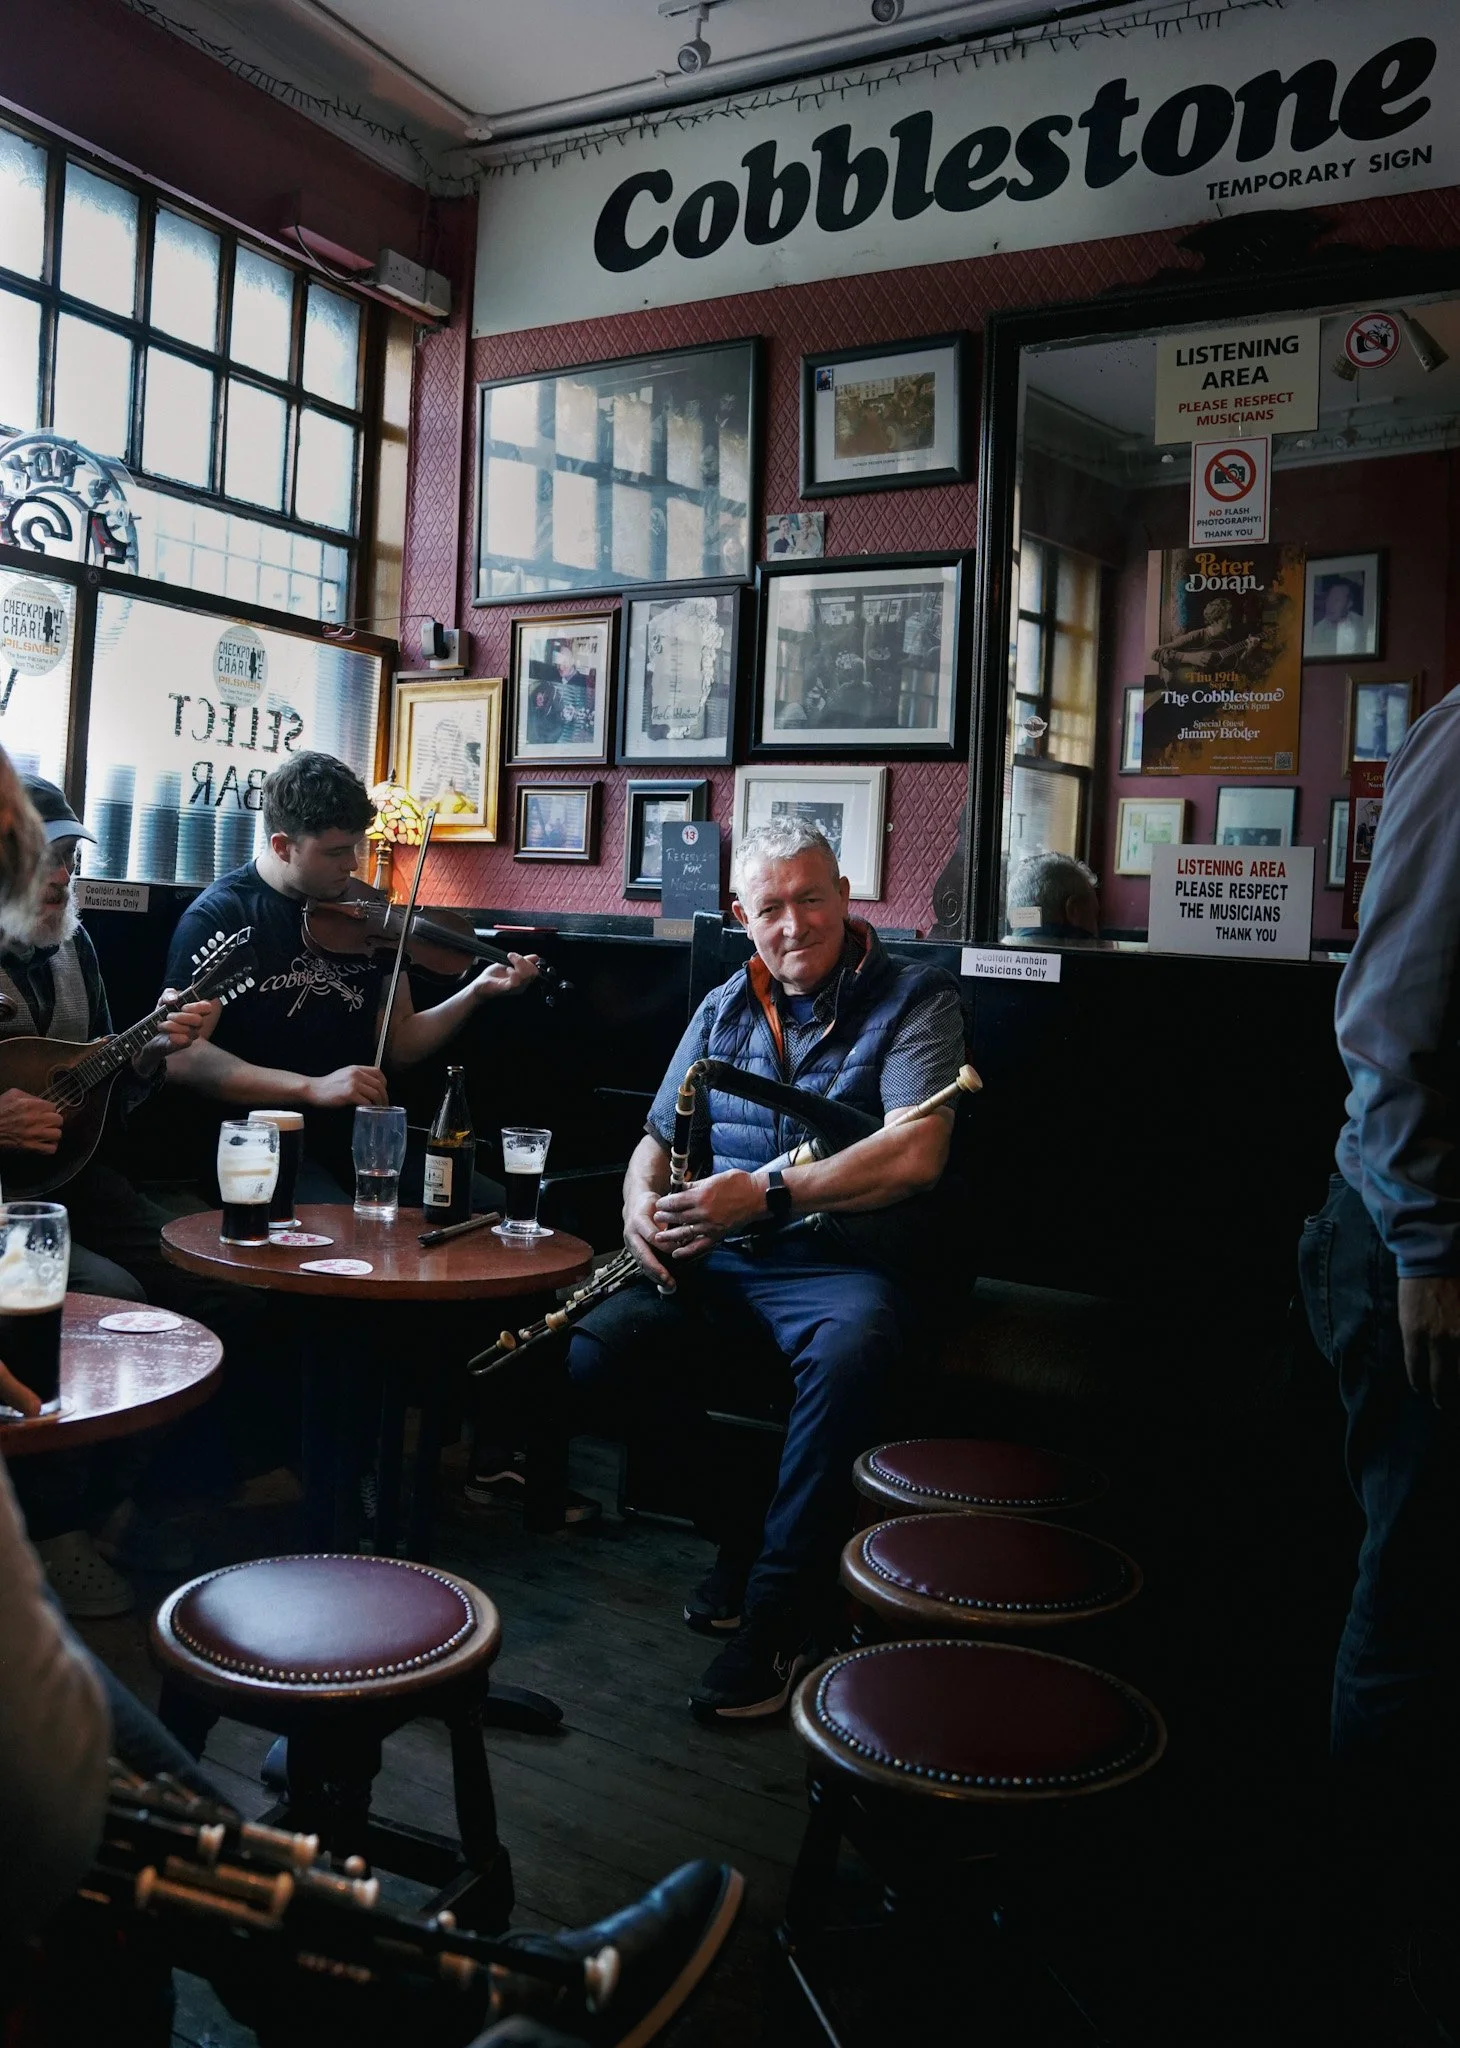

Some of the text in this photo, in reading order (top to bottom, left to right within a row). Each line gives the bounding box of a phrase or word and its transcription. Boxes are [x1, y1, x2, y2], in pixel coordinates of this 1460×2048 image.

[594, 37, 1438, 272] Cobblestone
[1207, 145, 1433, 200] TEMPORARY SIGN
[1176, 335, 1299, 366] LISTENING
[1202, 366, 1269, 390] AREA
[1178, 392, 1294, 413] PLEASE RESPECT
[1196, 409, 1274, 426] MUSICIANS
[1209, 507, 1250, 517] NO FLASH
[1204, 530, 1232, 538] THANK
[1195, 552, 1254, 576] Peter
[1185, 573, 1265, 595] Doran
[4, 638, 60, 656] PILSNER
[218, 675, 261, 690] PILSNER
[1186, 671, 1239, 683] Thu 19th
[1161, 688, 1285, 707] The Cobblestone
[1222, 702, 1270, 712] Doors 8pm
[1193, 719, 1244, 730] Special Guest
[1177, 727, 1260, 741] Jimmy Broder
[685, 831, 696, 840] 13
[1177, 858, 1286, 878] LISTENING AREA
[1175, 880, 1288, 900] PLEASE RESPECT
[84, 896, 139, 910] Musicians Only
[1179, 902, 1281, 922] THE MUSICIANS
[1216, 926, 1277, 942] THANK YOU
[975, 963, 1047, 980] Musicians Only
